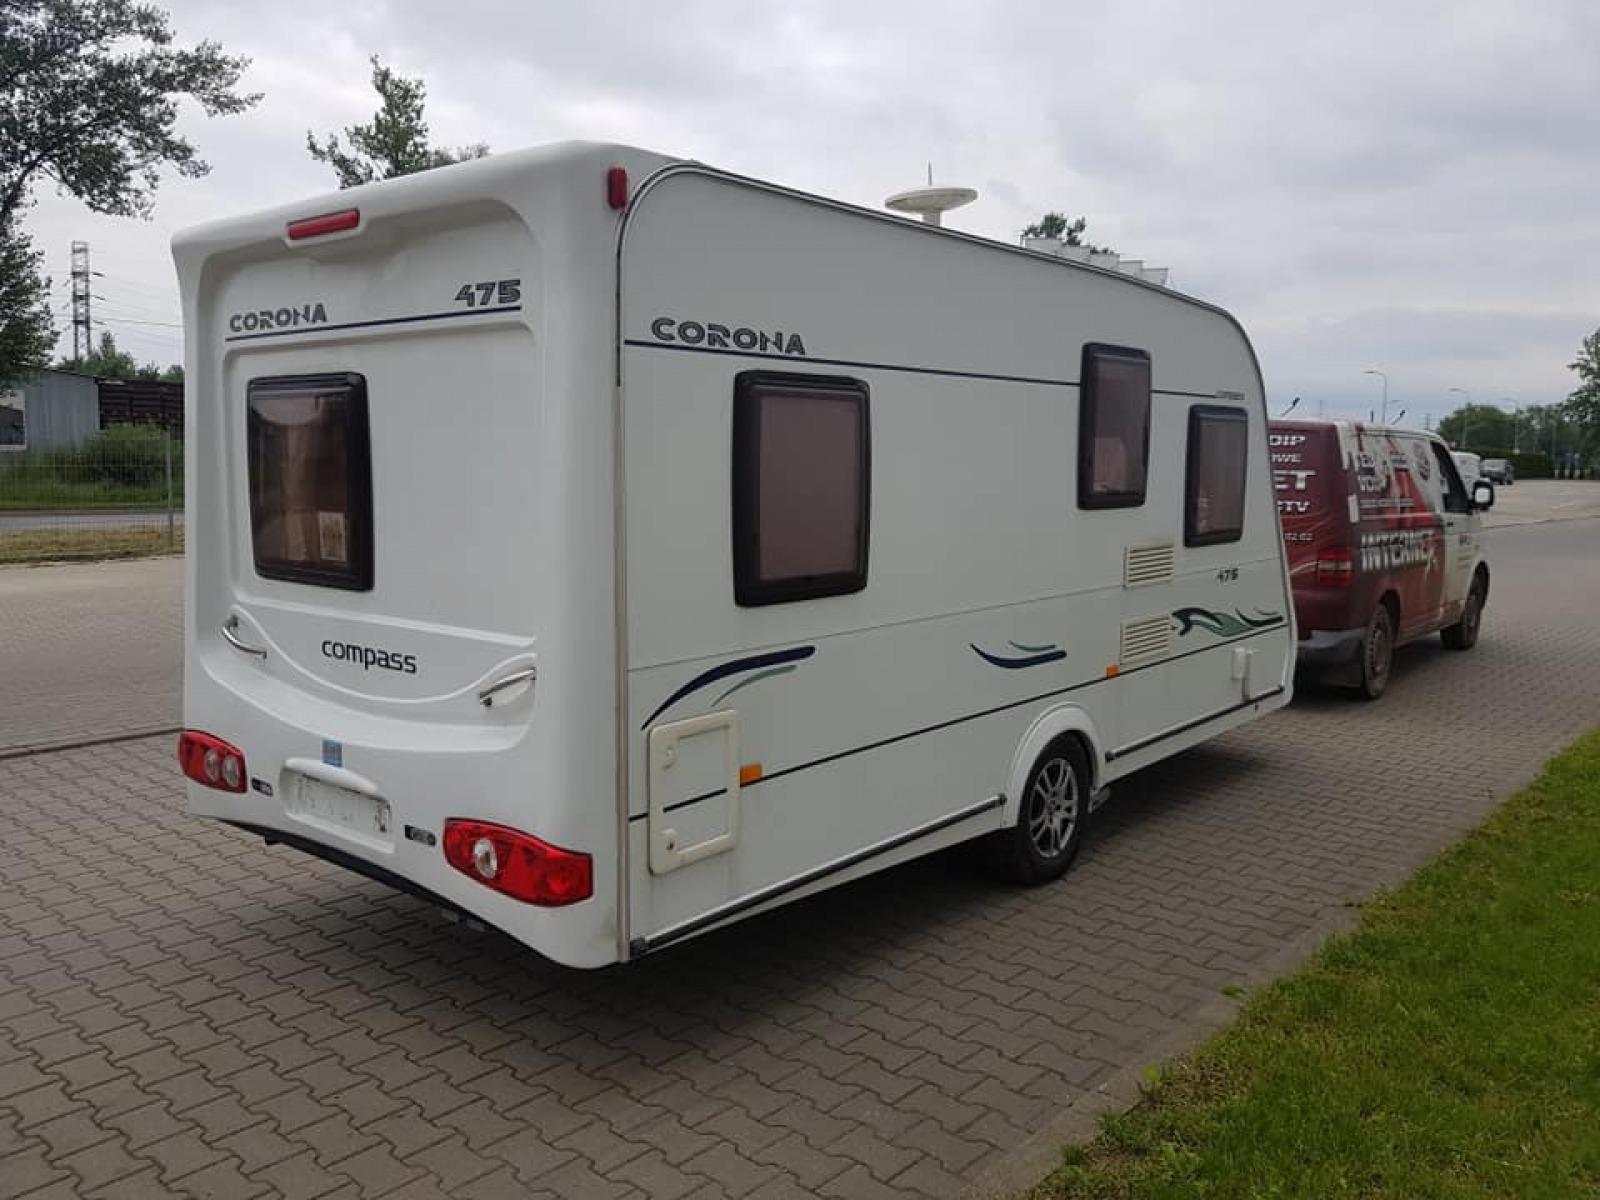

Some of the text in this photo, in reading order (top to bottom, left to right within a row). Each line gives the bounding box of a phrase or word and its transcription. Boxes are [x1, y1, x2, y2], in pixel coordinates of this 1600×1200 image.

[454, 279, 521, 307] 475
[229, 302, 328, 333] CORONA
[651, 317, 806, 356] CORONA
[321, 640, 417, 674] compass
